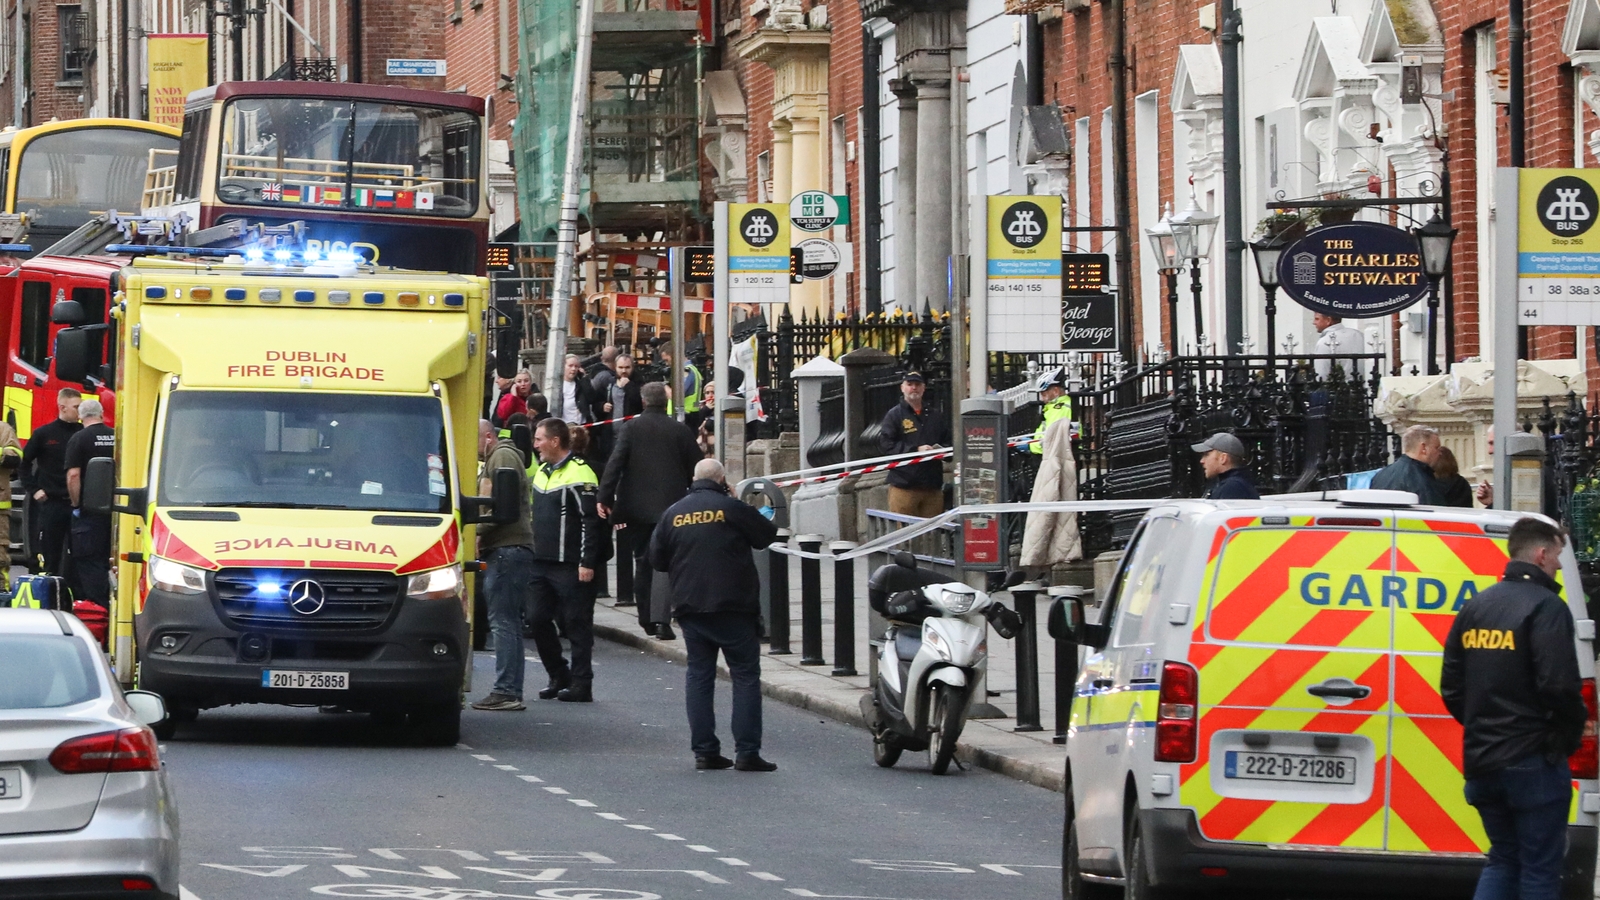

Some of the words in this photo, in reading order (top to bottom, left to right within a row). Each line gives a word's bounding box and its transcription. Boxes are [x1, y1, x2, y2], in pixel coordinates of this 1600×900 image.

[156, 87, 183, 95] ANDY
[154, 96, 187, 105] WARH
[154, 106, 185, 114] THRE
[1556, 221, 1580, 230] BUS
[1323, 239, 1354, 249] THE
[1322, 253, 1421, 267] CHARLES
[1322, 271, 1421, 286] STEWART
[988, 284, 1005, 292] 46a
[1008, 284, 1024, 292] 140
[1026, 284, 1042, 292] 155
[1528, 285, 1533, 294] 1
[1547, 285, 1562, 295] 38
[1568, 285, 1590, 295] 38a
[1303, 290, 1330, 306] Ensuite
[1332, 301, 1353, 310] Guest
[1356, 293, 1411, 310] Accommodation
[1523, 309, 1538, 318] 44
[1062, 321, 1114, 345] George
[266, 350, 347, 363] DUBLIN
[228, 365, 276, 378] FIRE
[285, 365, 385, 382] BRIGADE
[673, 509, 726, 528] GARDA
[1300, 571, 1481, 612] GARDA
[274, 673, 345, 688] 201-D-25858
[1246, 756, 1346, 779] 222-D-21286
